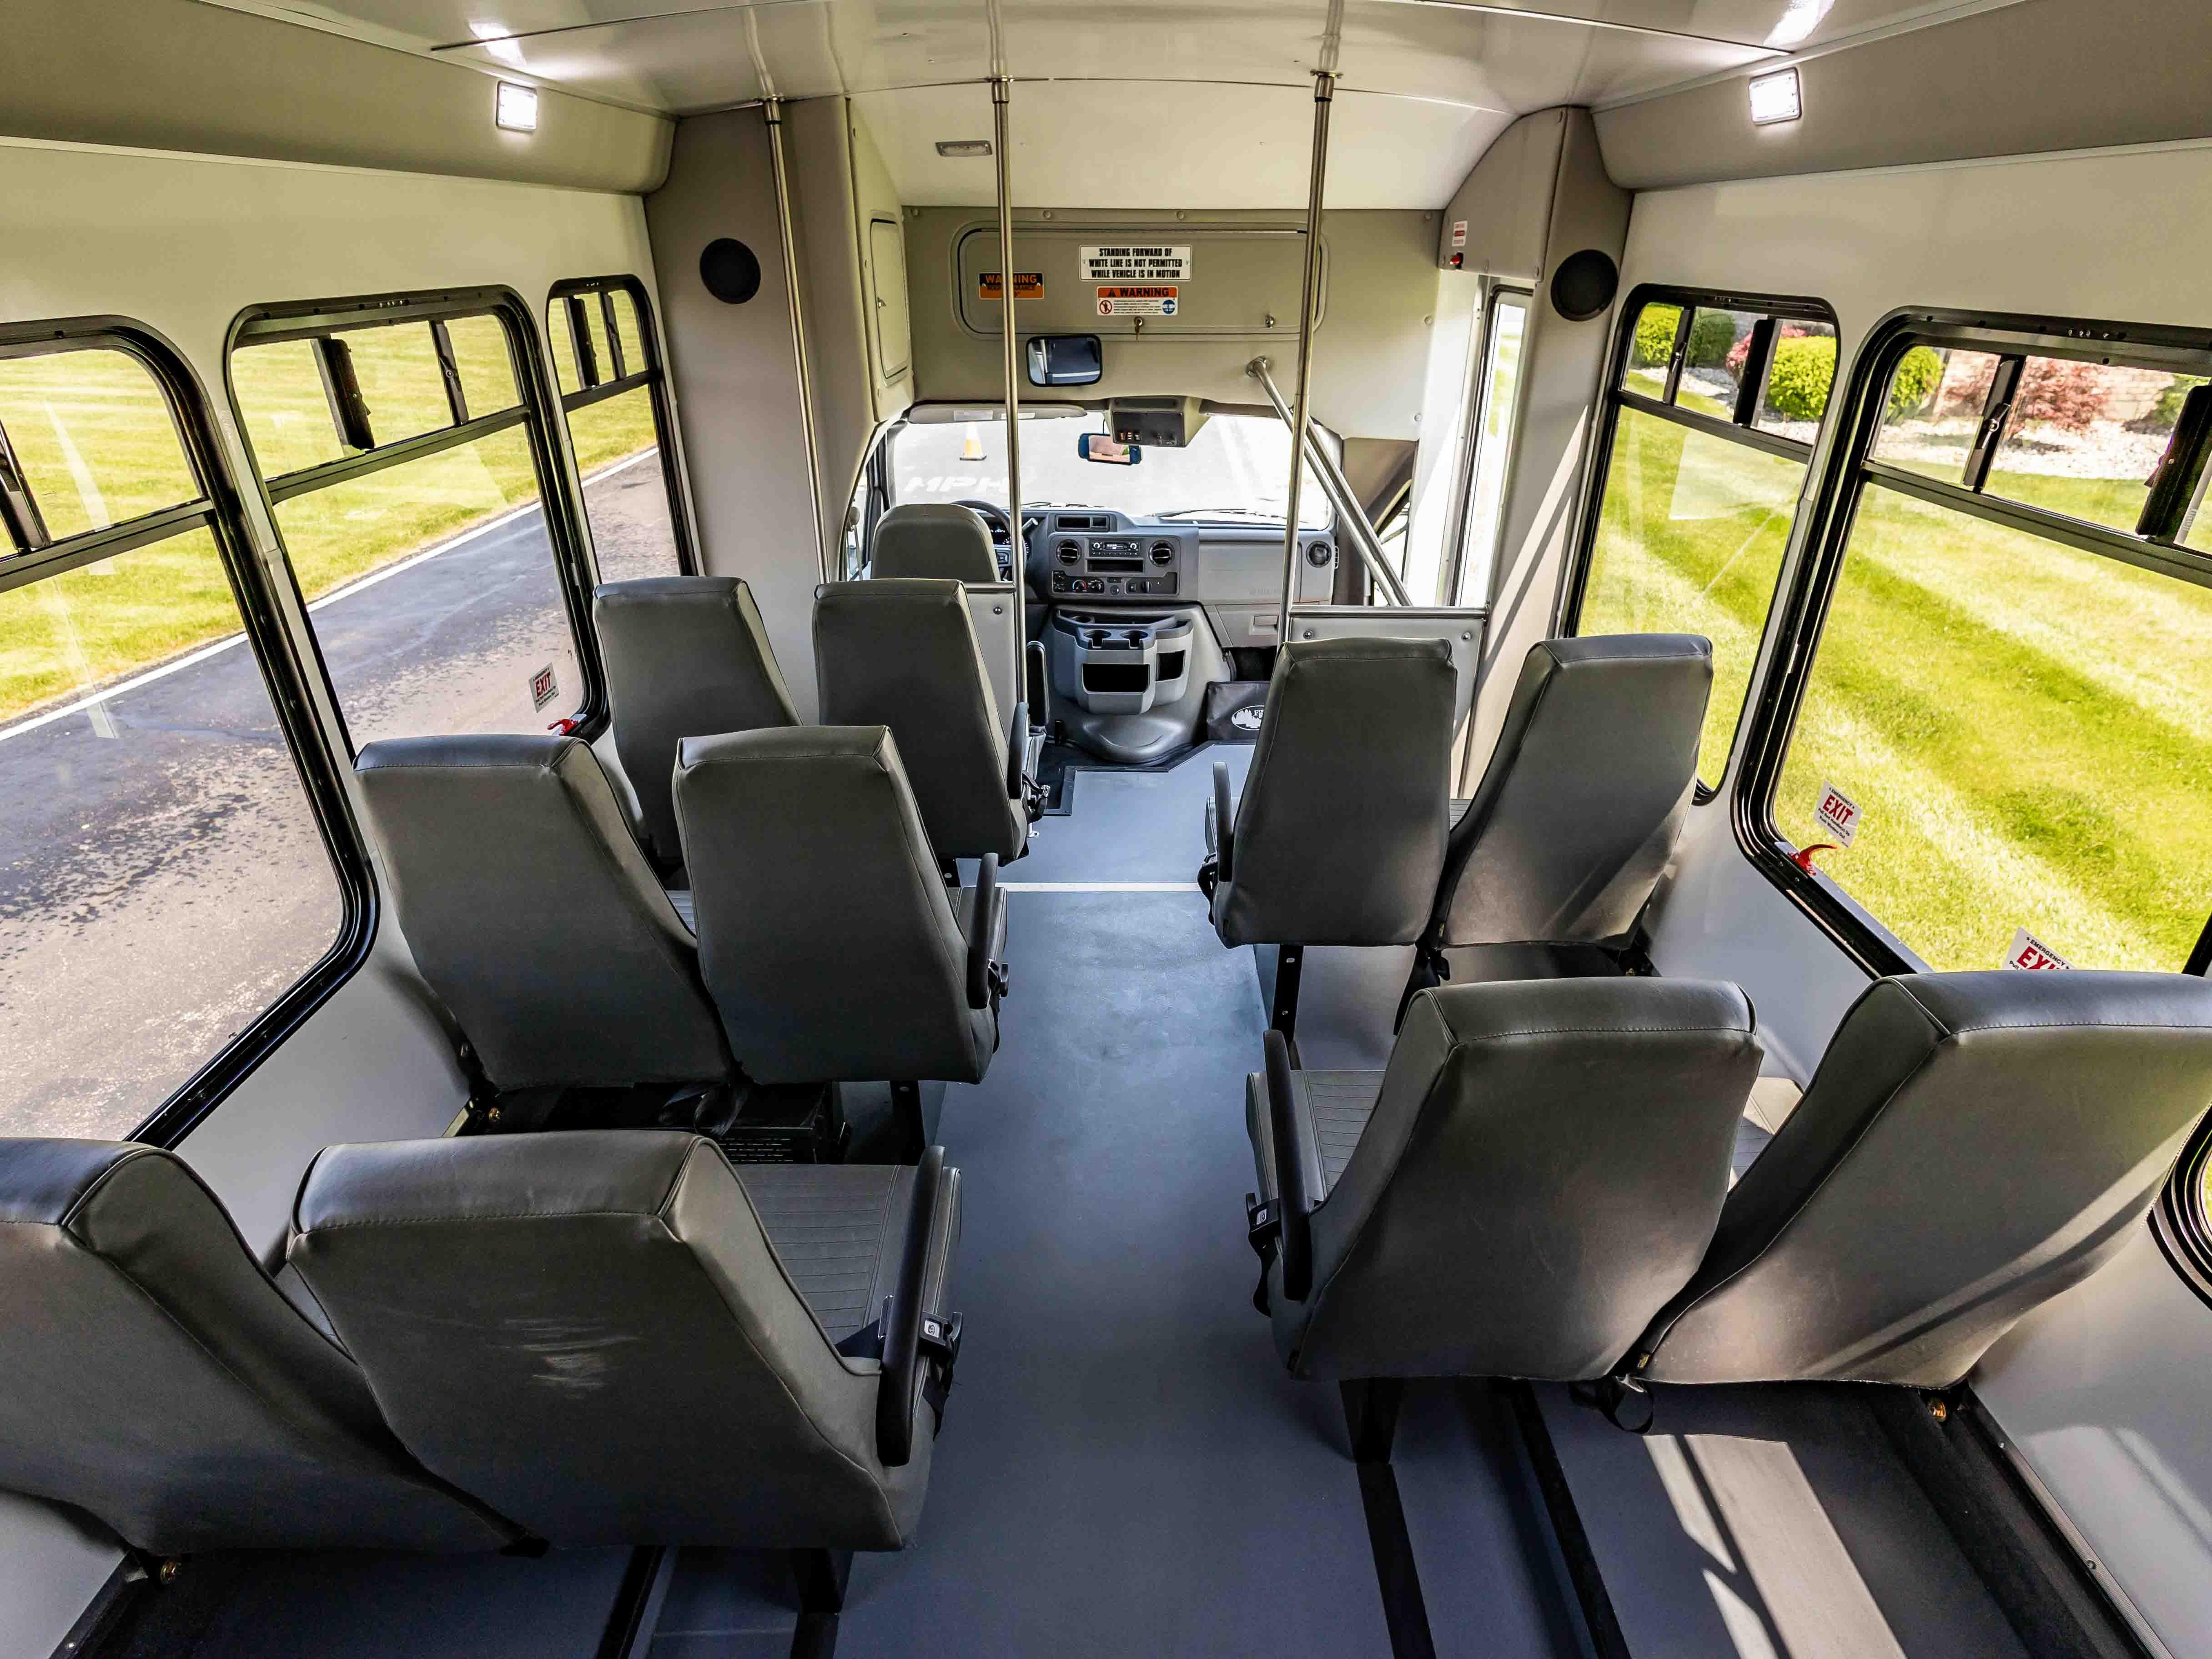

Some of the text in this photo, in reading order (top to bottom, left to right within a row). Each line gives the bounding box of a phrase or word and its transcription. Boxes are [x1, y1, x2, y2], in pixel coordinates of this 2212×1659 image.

[1099, 248, 1172, 256] STANDING FORWARD OF
[1089, 259, 1182, 267] WHITE LINE IS NOT PERMITTED
[985, 274, 1037, 283] WANING
[1091, 269, 1180, 278] WHILE VEHICLE IS IN MOTION
[1120, 288, 1169, 297] WARNING
[535, 671, 551, 698] EXIT
[1831, 789, 1852, 807] EMERGENCY
[1822, 794, 1854, 825] EXIT
[2016, 946, 2060, 970] EX
[2030, 939, 2066, 966] EMERGENCY
